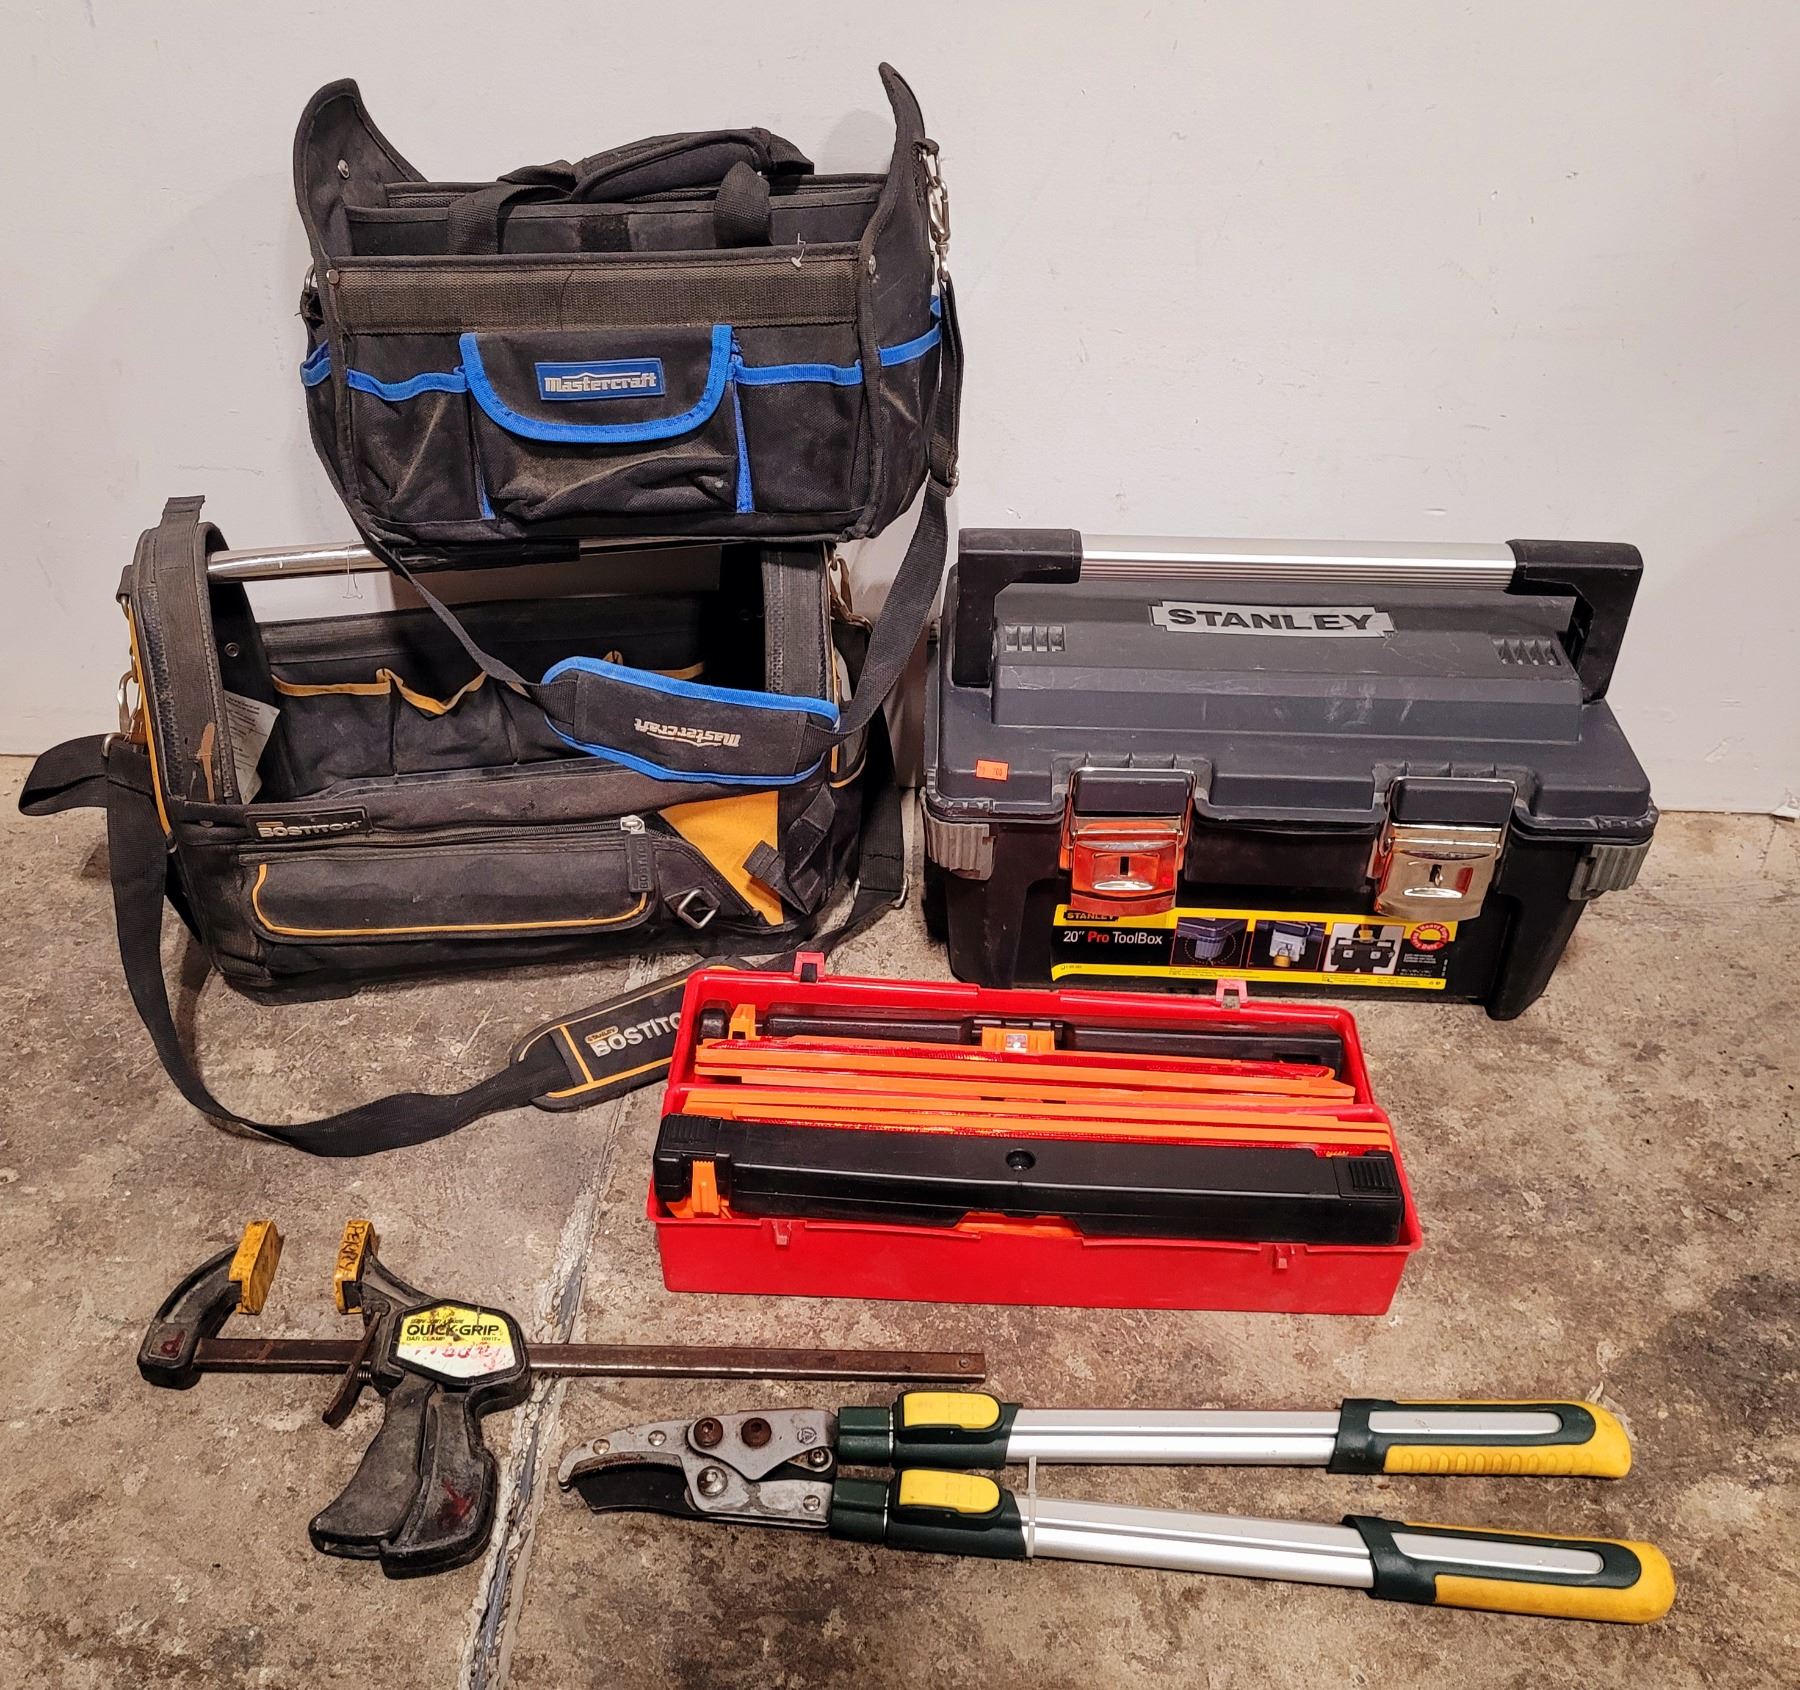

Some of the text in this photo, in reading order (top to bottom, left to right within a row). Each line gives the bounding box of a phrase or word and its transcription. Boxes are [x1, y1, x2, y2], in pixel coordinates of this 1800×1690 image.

[544, 372, 657, 393] Mastercraft
[1168, 608, 1373, 631] STANLEY
[633, 718, 742, 747] Mastercraft
[1087, 931, 1110, 944] Pro
[1112, 931, 1163, 945] ToolBox
[589, 1012, 682, 1058] BOSTITC
